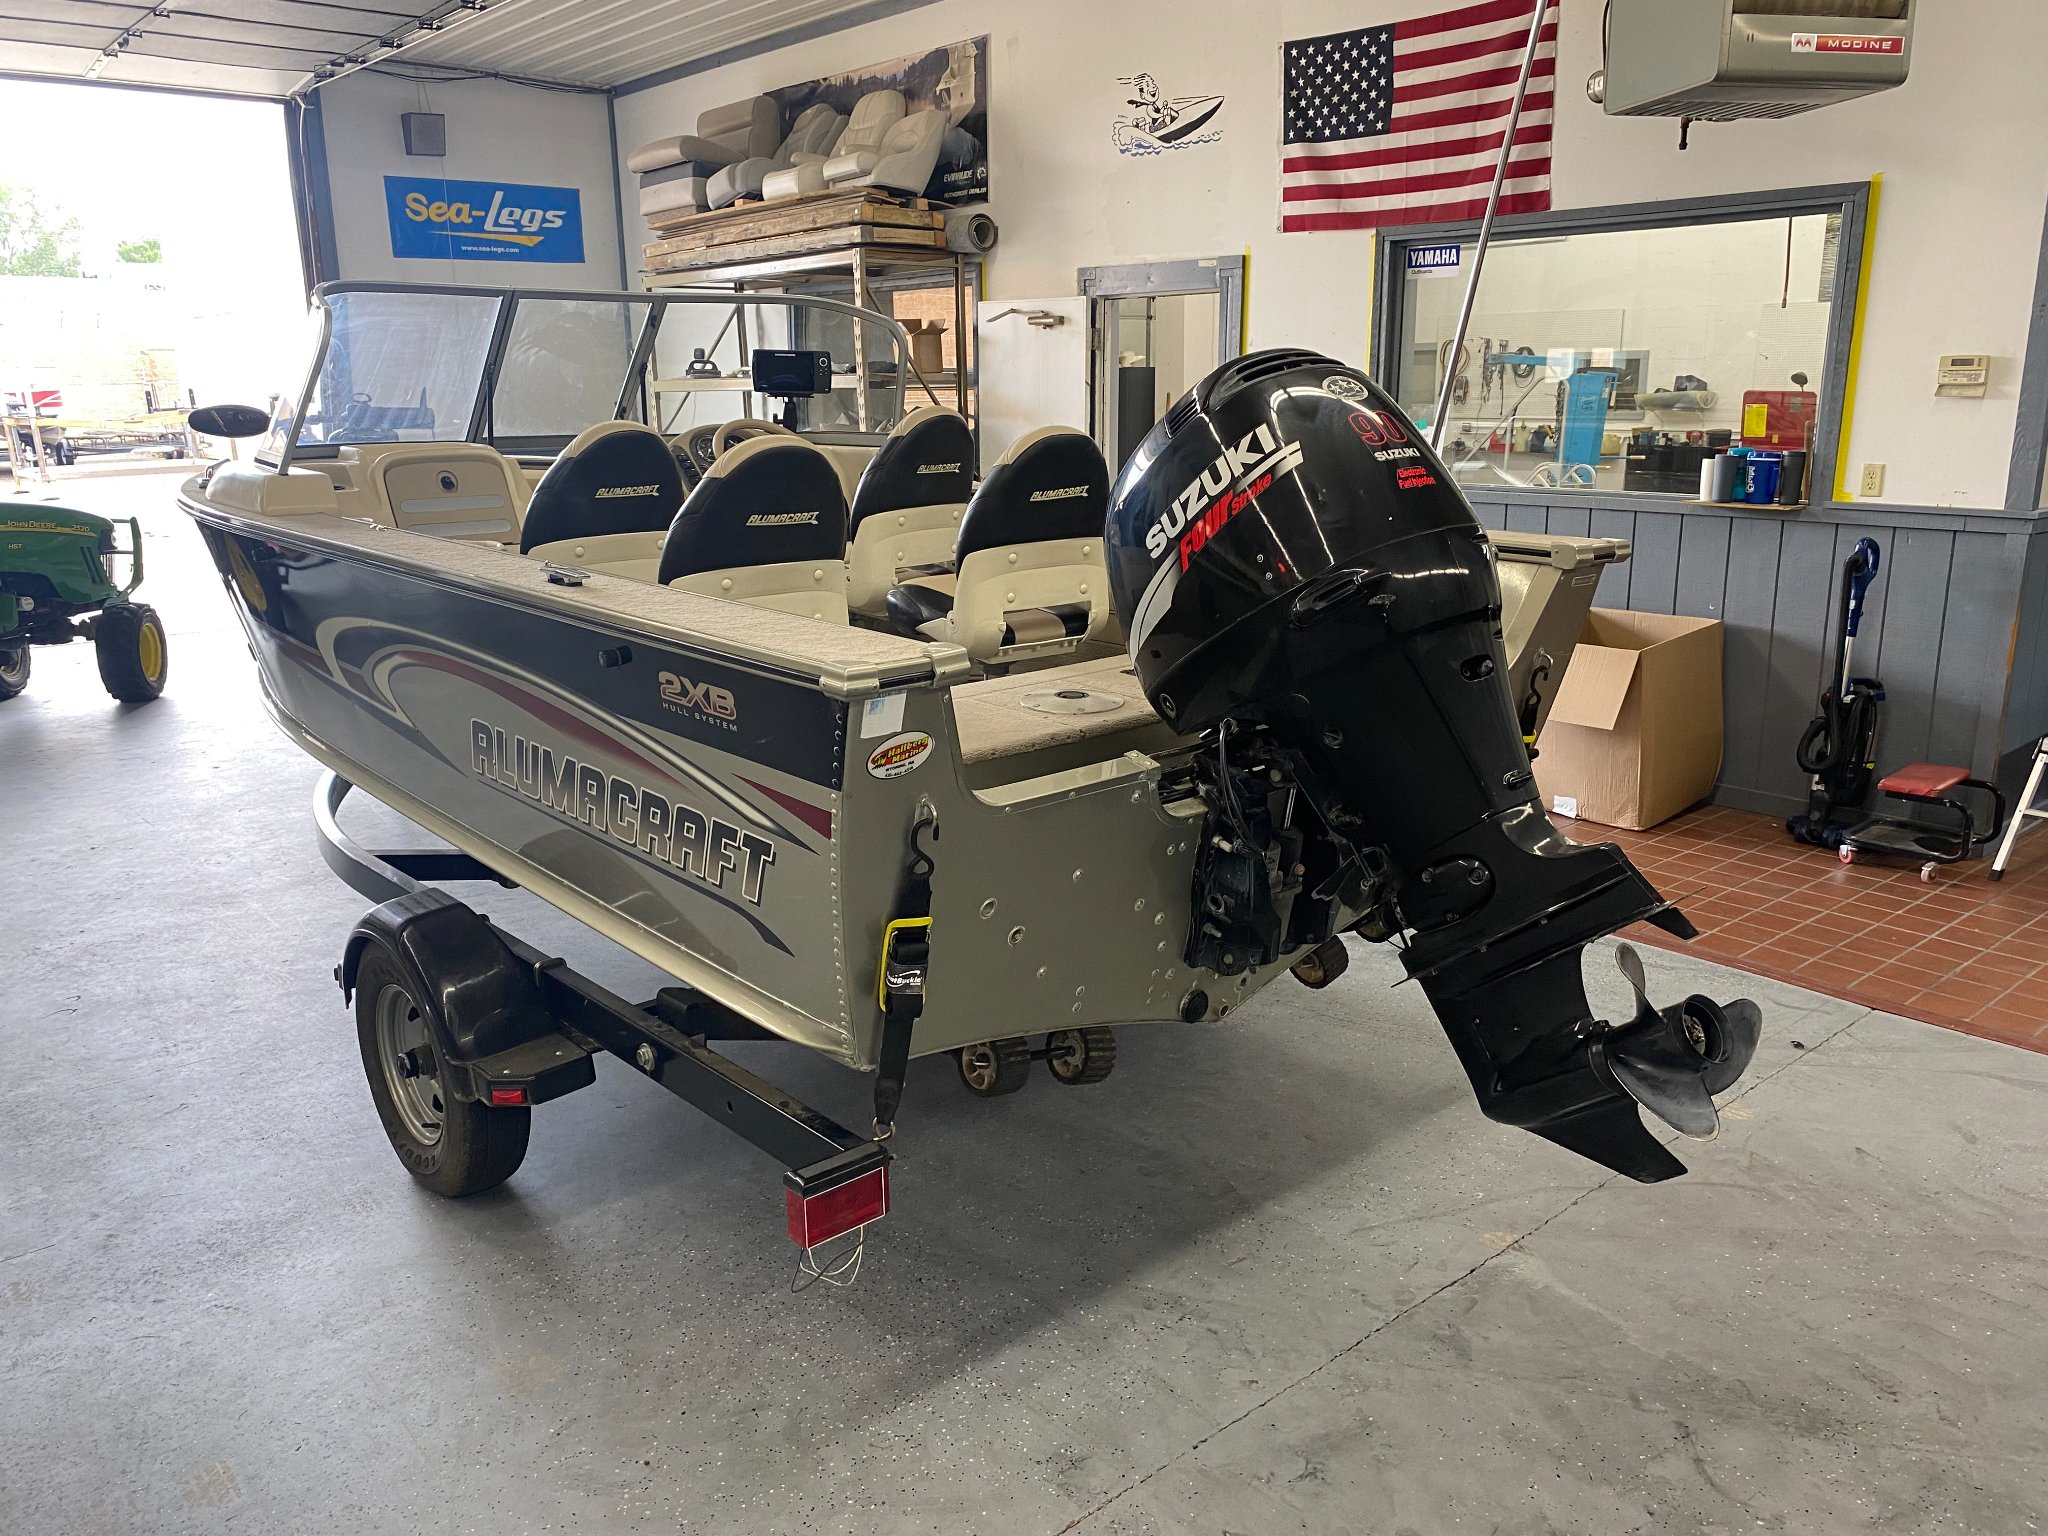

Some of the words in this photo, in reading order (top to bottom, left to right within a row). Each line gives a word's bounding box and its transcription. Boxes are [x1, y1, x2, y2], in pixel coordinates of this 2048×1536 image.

[1827, 40, 1892, 49] MODINE
[943, 169, 973, 182] EVINRUDE
[405, 190, 567, 233] Sea-Legs
[461, 244, 520, 254] www.sea-legs.com
[1410, 248, 1458, 266] YAMAHA
[1347, 410, 1408, 446] 90
[1373, 447, 1420, 462] SUZUKI
[917, 463, 961, 473] ALUMACRAFT
[595, 484, 660, 498] ALUMACRAFT
[1030, 485, 1090, 501] ALUMACRAFT
[1145, 423, 1277, 559] SUZUKI
[1231, 473, 1272, 516] Stroke
[7, 520, 28, 528] JOHN
[28, 520, 57, 529] DEERE
[71, 524, 90, 532] 2520
[746, 511, 820, 525] ALUMACRAFT
[658, 671, 737, 720] 2XB
[662, 701, 690, 717] HULL
[694, 712, 738, 732] SYSTEM
[888, 736, 929, 757] Hallberg
[892, 747, 924, 764] Marine
[470, 718, 776, 907] ALUMACRAFT
